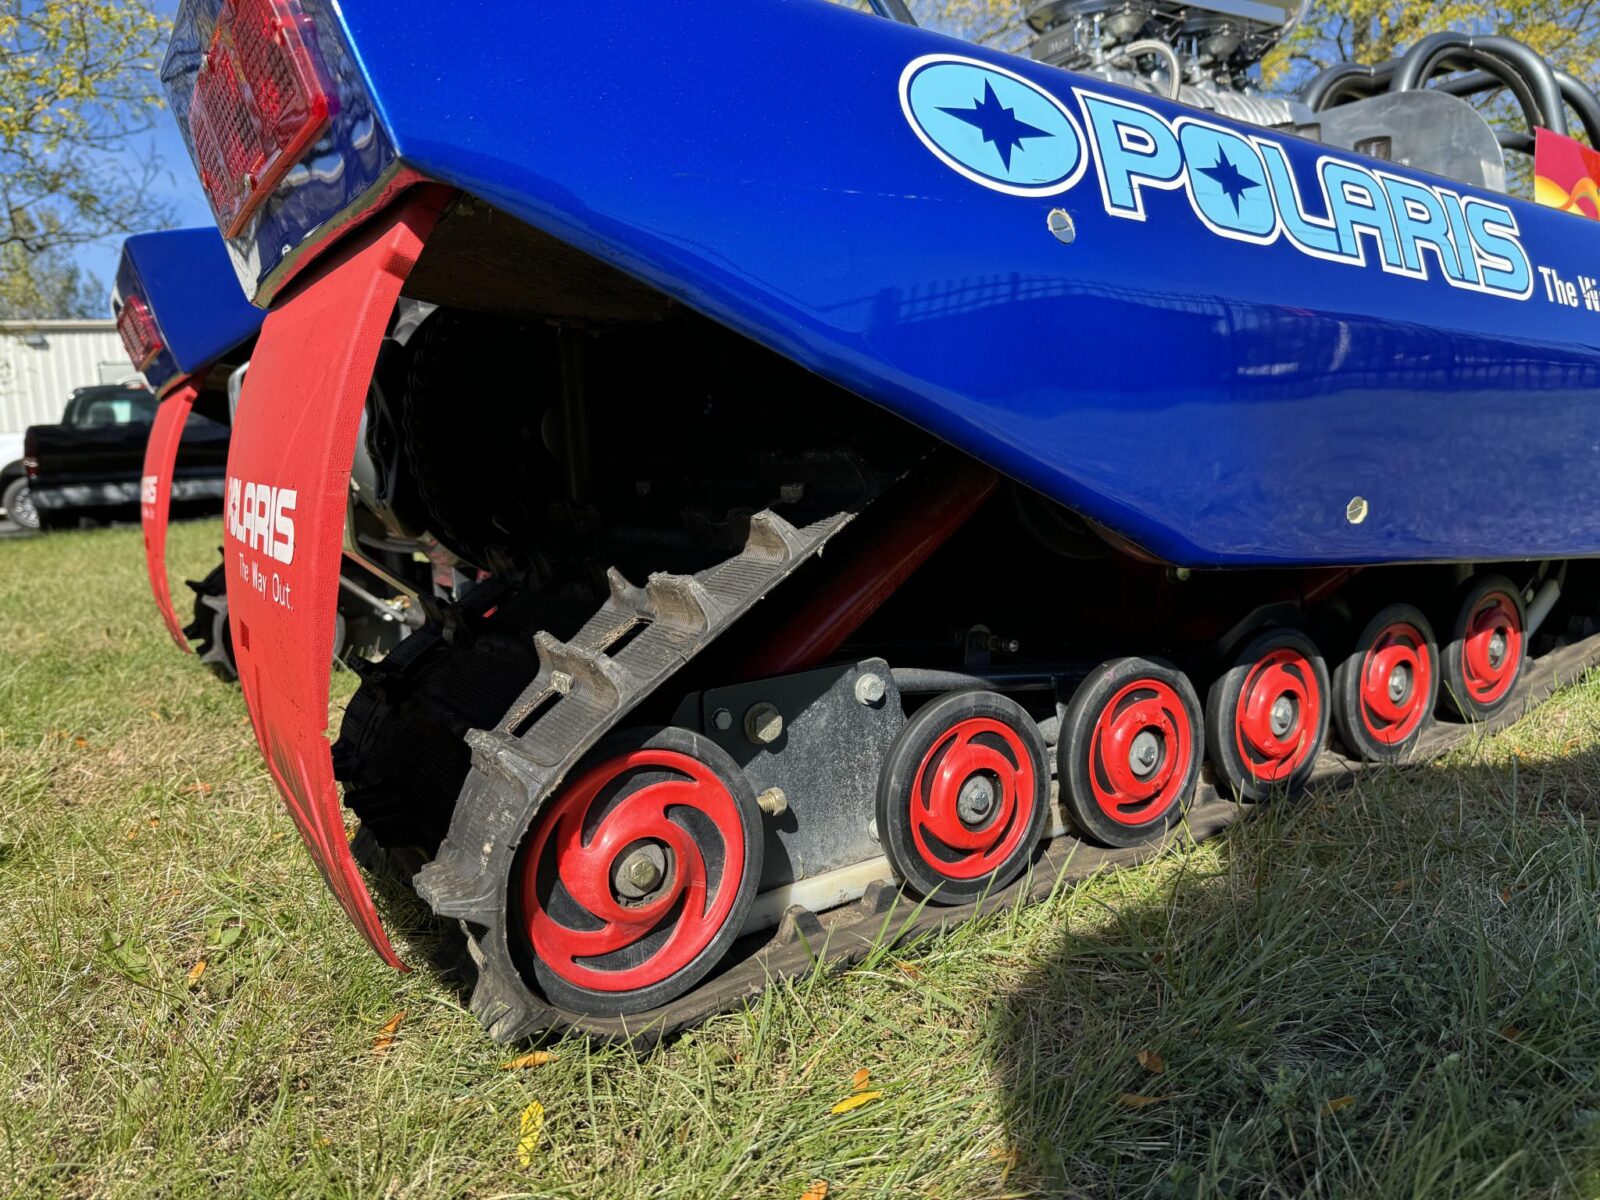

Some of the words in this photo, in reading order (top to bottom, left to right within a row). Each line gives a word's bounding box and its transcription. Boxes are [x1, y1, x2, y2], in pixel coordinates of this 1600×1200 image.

[1072, 86, 1534, 300] POLARIS
[1538, 265, 1579, 308] The
[239, 552, 249, 583] The
[251, 560, 267, 601] Way
